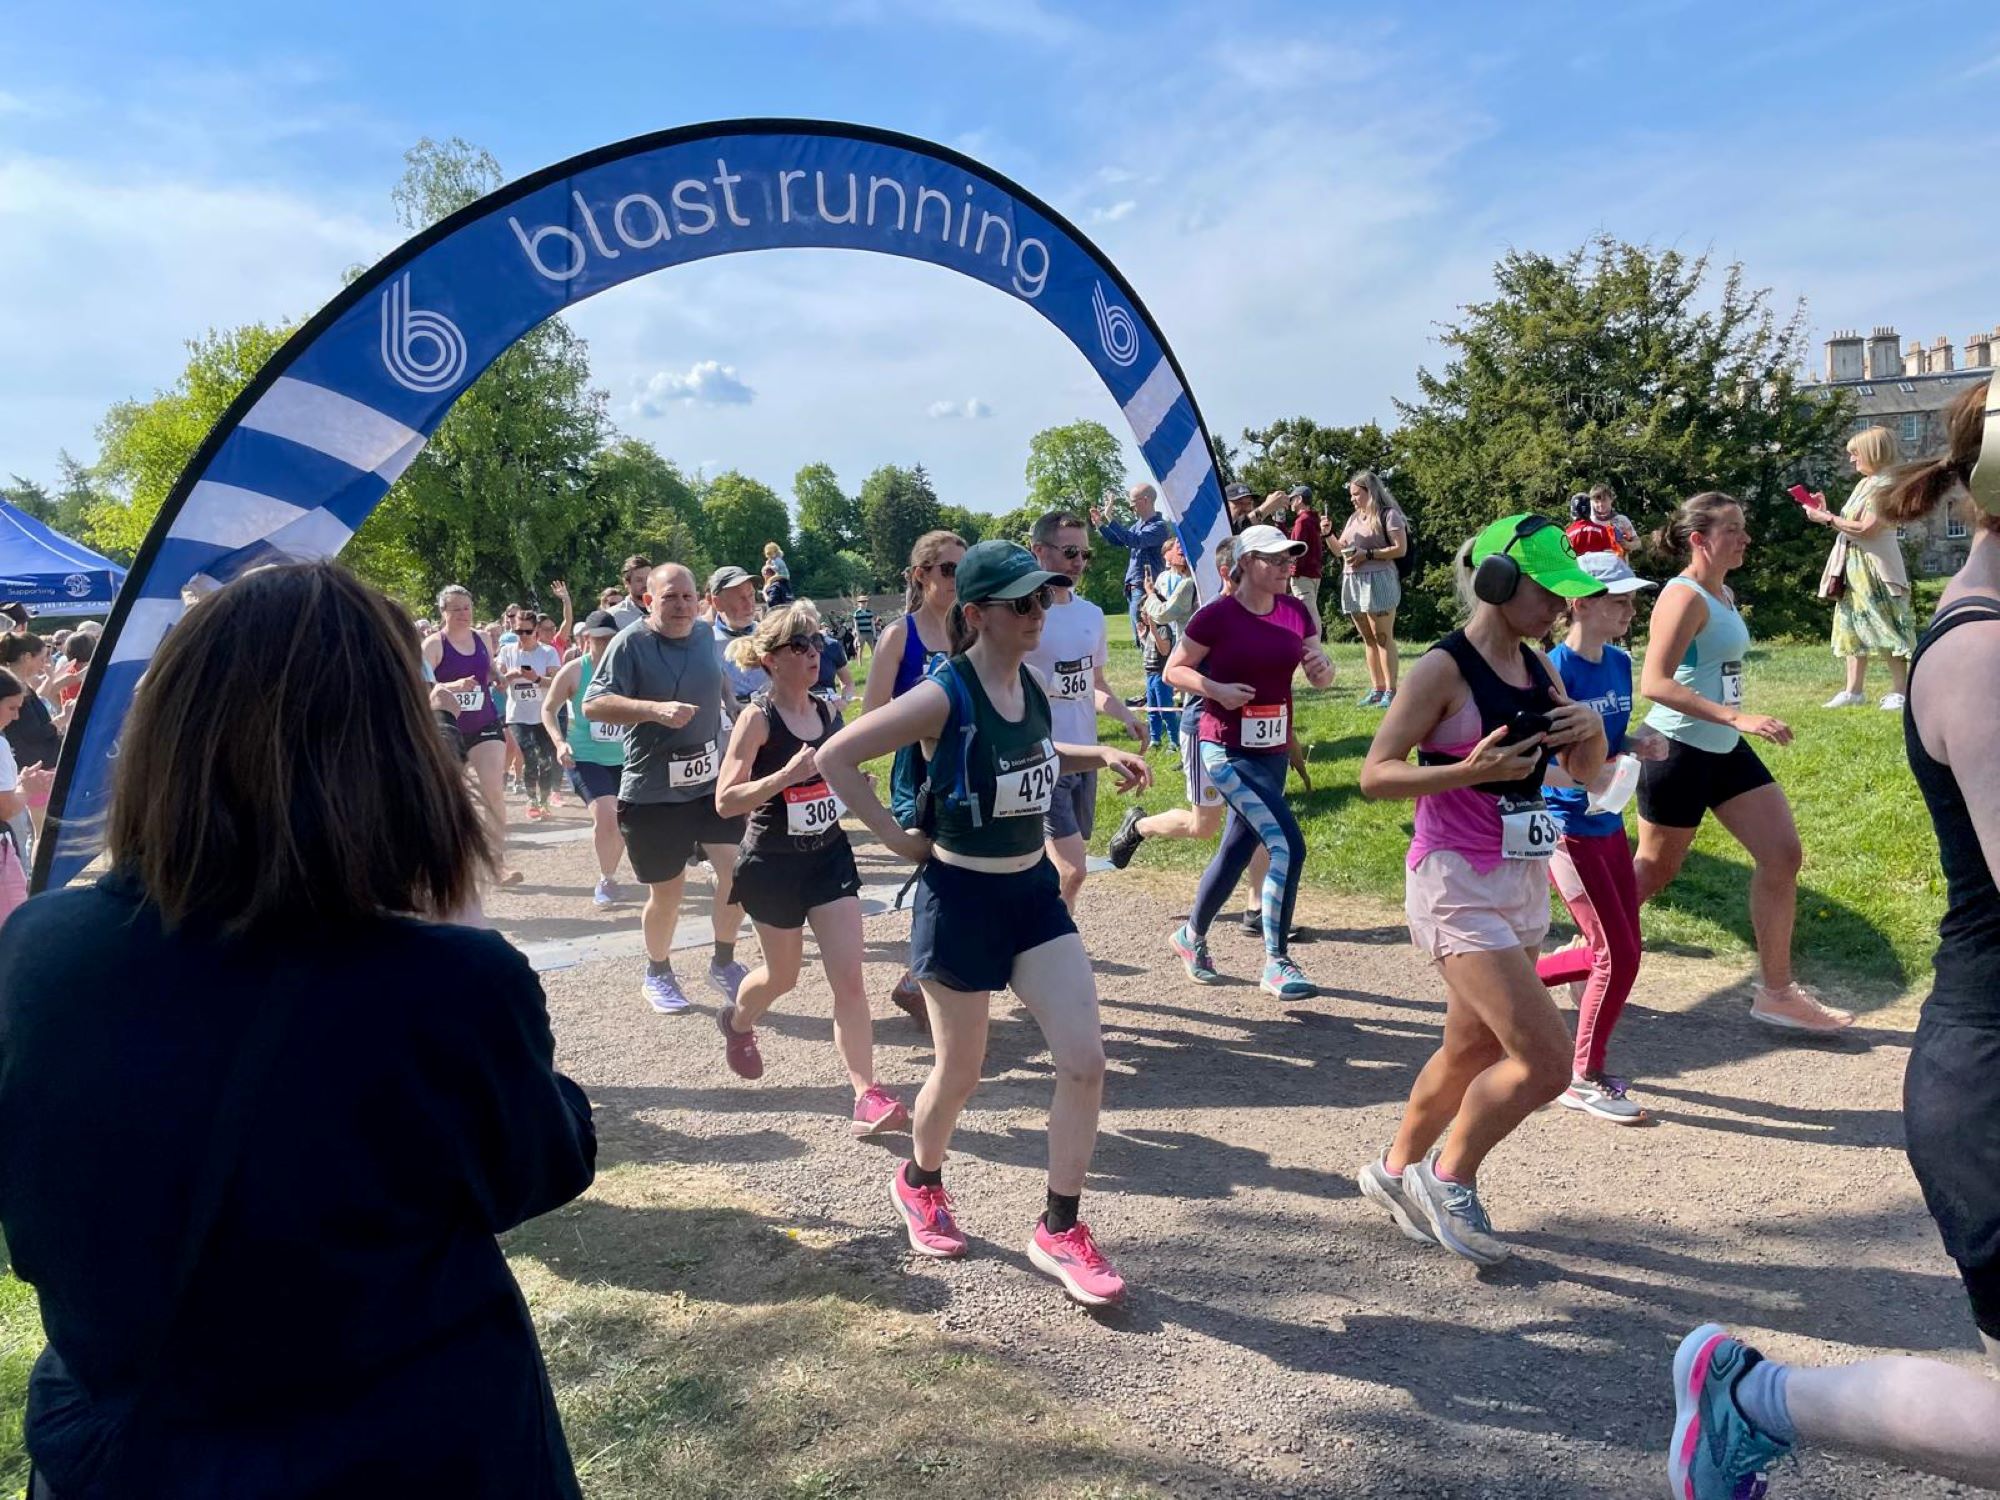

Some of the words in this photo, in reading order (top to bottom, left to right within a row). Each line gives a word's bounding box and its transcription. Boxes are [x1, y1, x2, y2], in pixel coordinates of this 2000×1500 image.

[508, 158, 750, 281] blast
[779, 169, 1050, 299] running
[520, 690, 537, 699] 643
[1061, 672, 1087, 696] 366
[456, 694, 477, 706] 387
[600, 723, 621, 737] 407
[1256, 719, 1282, 739] 314
[684, 756, 712, 778] 605
[1019, 764, 1055, 803] 429
[805, 798, 837, 827] 308
